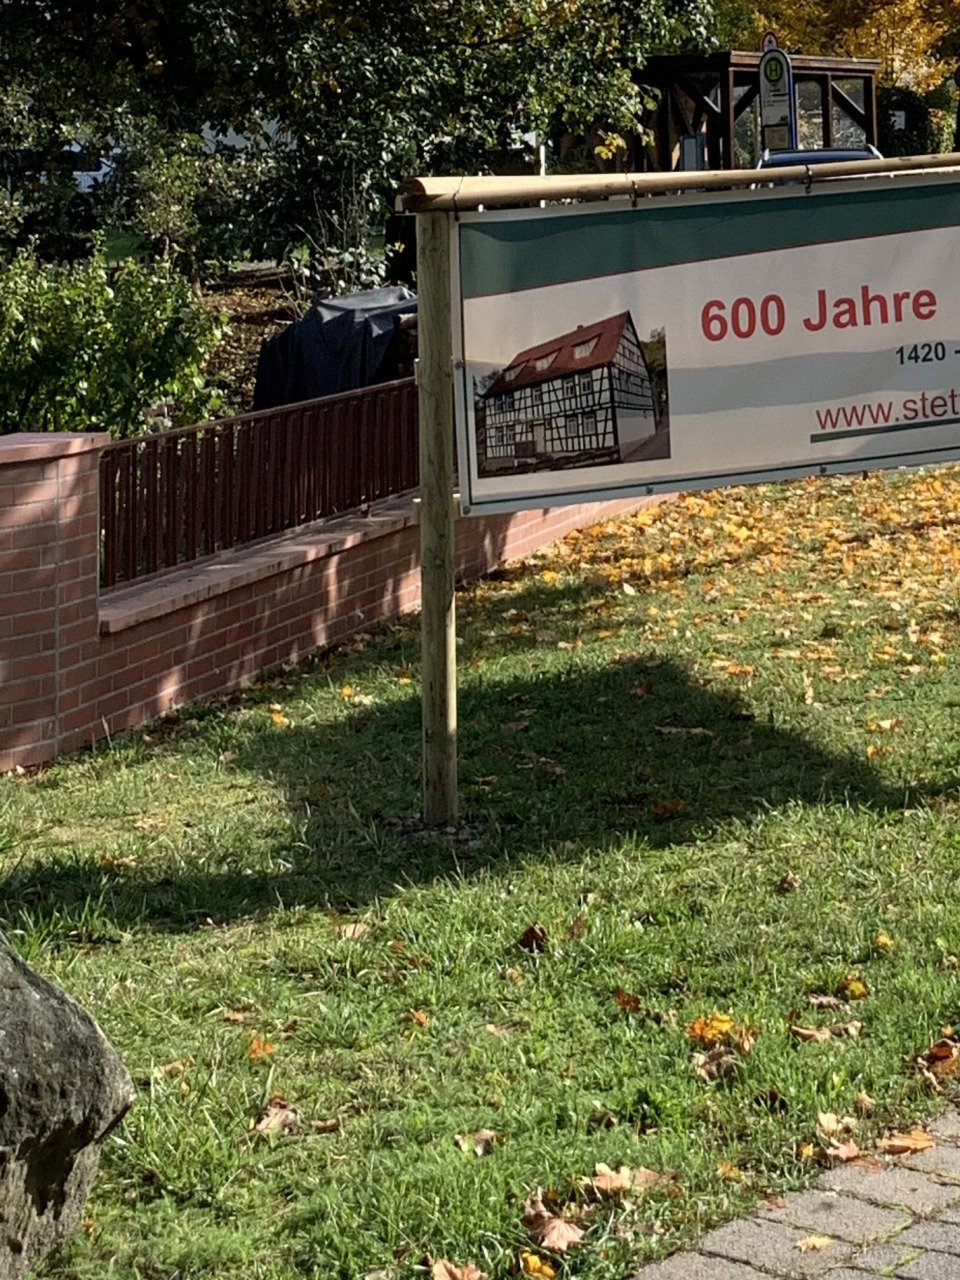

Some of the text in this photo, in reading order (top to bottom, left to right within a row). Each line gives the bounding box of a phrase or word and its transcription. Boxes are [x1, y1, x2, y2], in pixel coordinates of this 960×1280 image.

[701, 293, 786, 342] 600
[803, 284, 938, 332] Jahre
[895, 341, 946, 365] 1420
